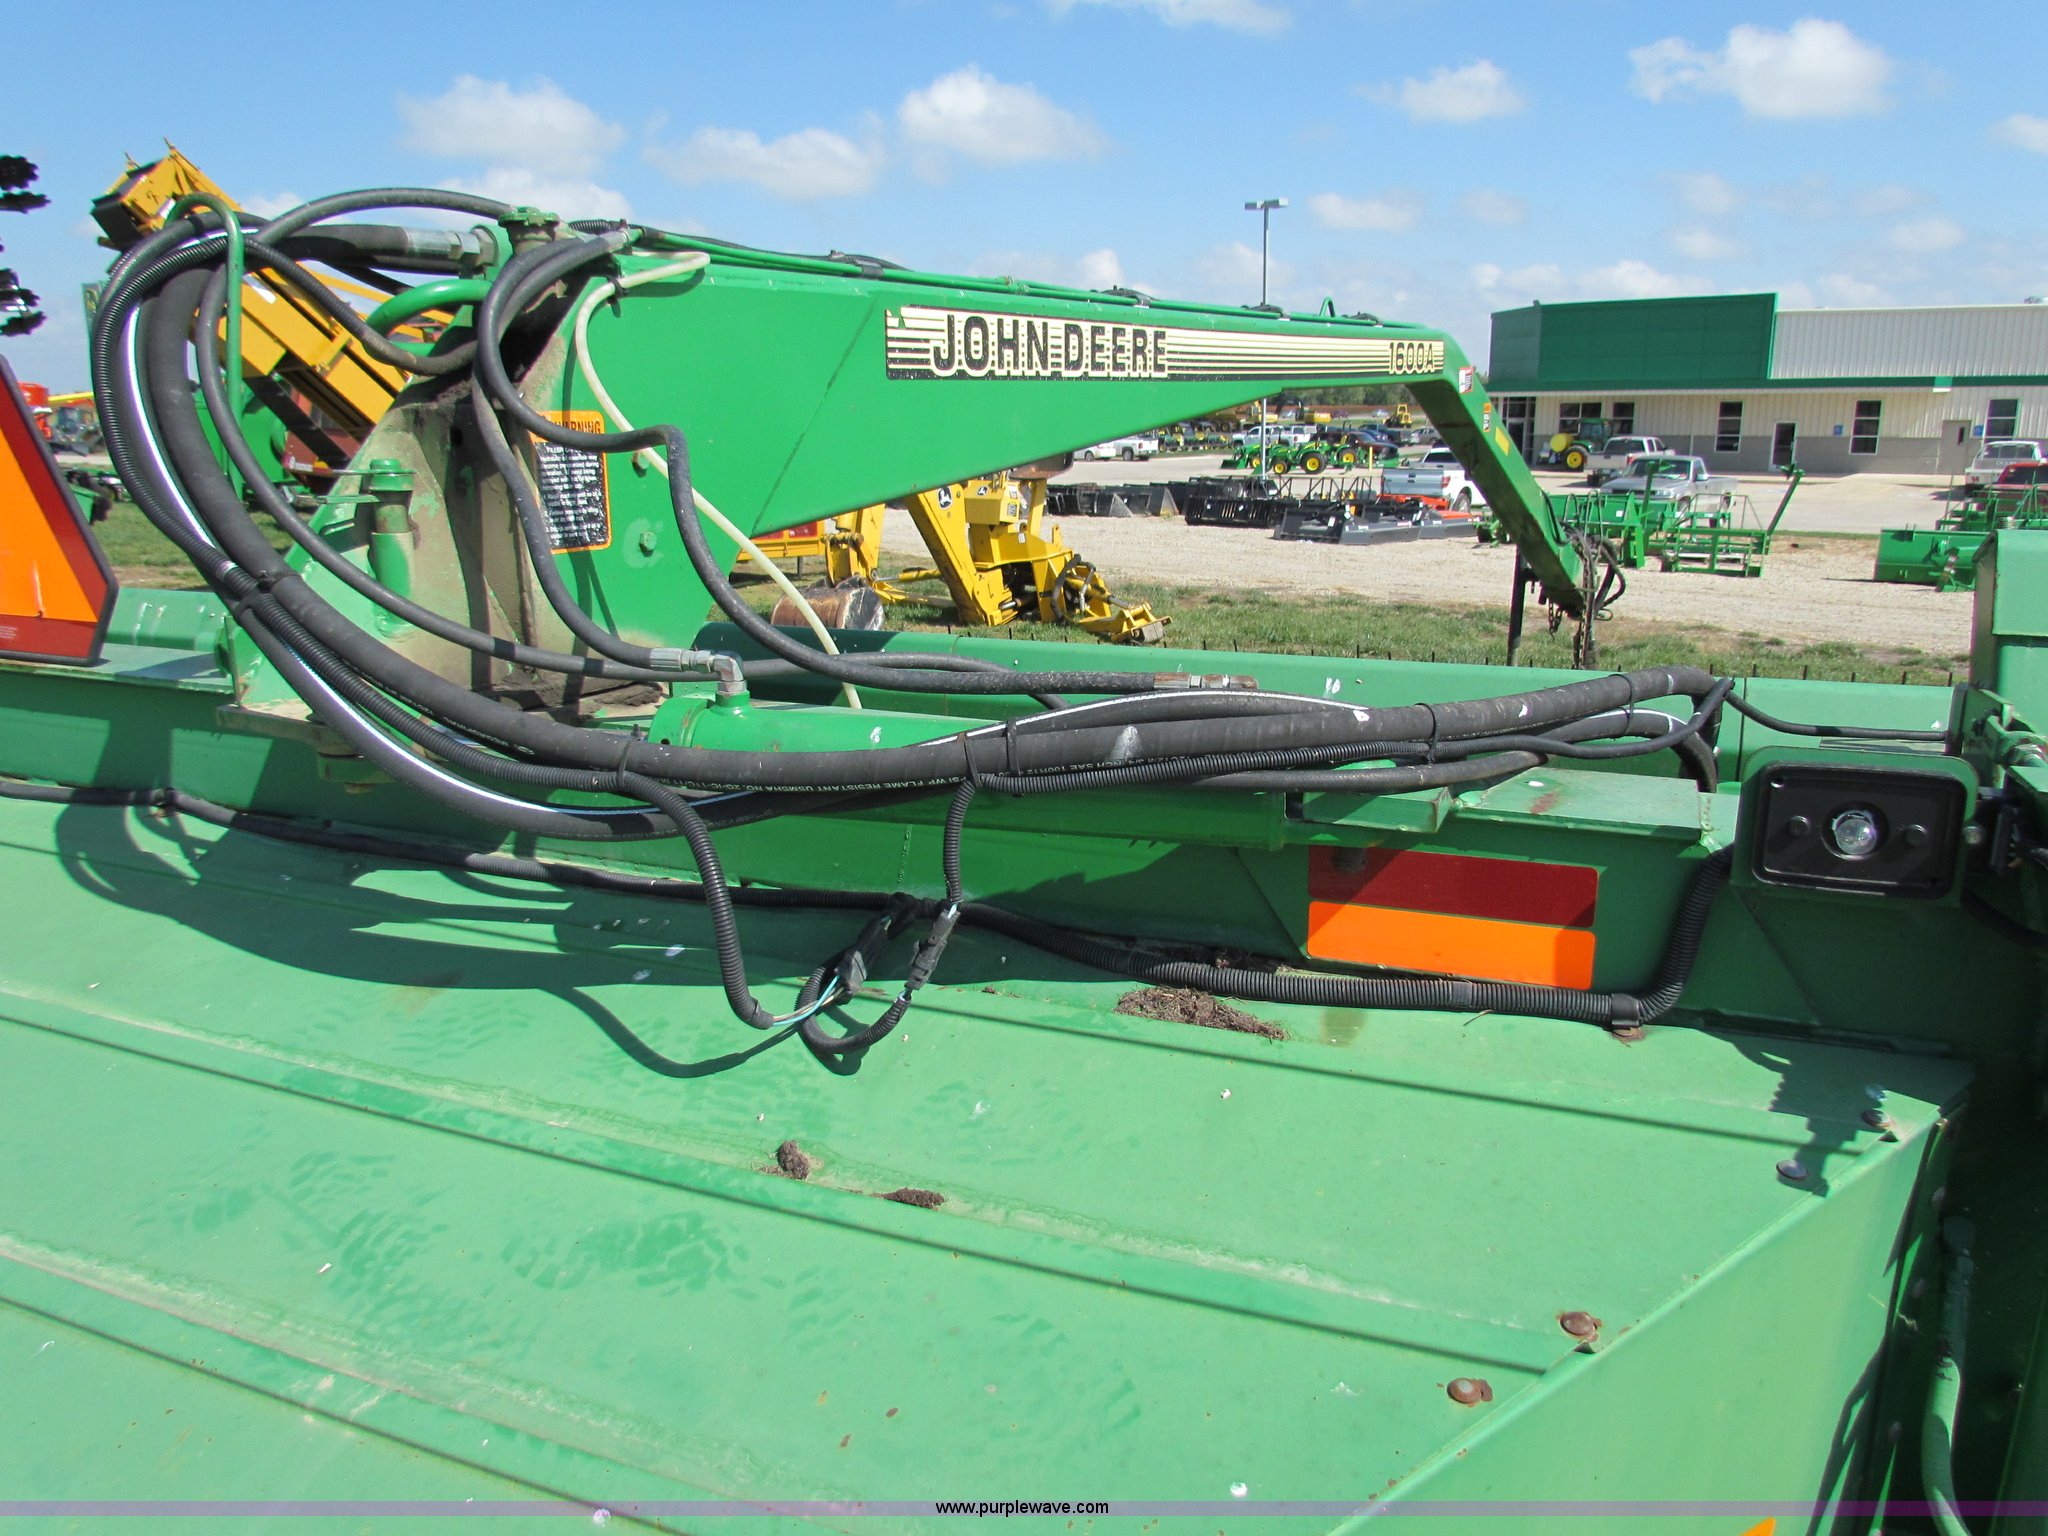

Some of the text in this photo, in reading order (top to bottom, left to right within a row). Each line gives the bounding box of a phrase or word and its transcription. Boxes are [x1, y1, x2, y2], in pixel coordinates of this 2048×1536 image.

[932, 314, 1434, 373] JOHN DEERE 1600A
[555, 421, 601, 434] RNING
[816, 783, 882, 793] RESISTANT
[883, 779, 925, 789] FLAME
